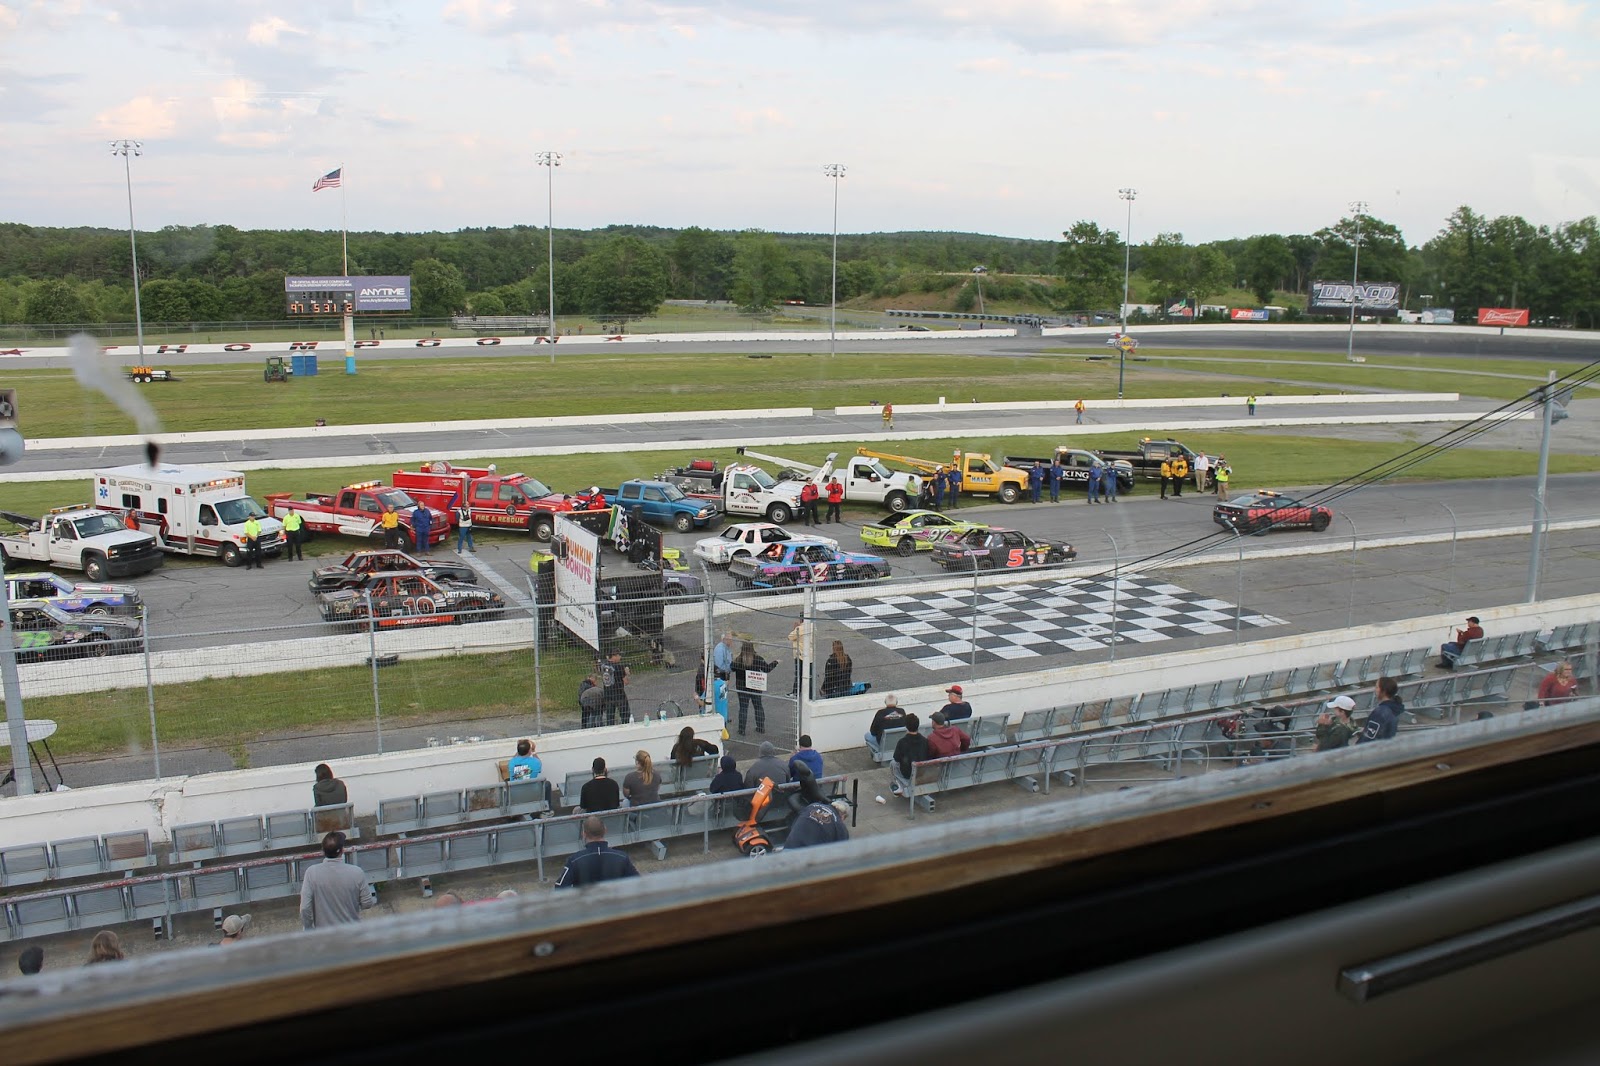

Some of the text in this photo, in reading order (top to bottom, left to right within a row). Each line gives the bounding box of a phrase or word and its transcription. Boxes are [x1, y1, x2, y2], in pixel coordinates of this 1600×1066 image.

[1318, 285, 1396, 302] DRACO
[290, 303, 353, 313] 97 5 31 2
[1062, 470, 1090, 479] KING
[476, 514, 489, 522] FIRE
[891, 529, 908, 537] BD
[927, 527, 952, 544] 97
[1006, 549, 1025, 567] 5
[565, 556, 592, 585] DONUTS
[809, 563, 829, 582] 2
[402, 596, 436, 616] 10
